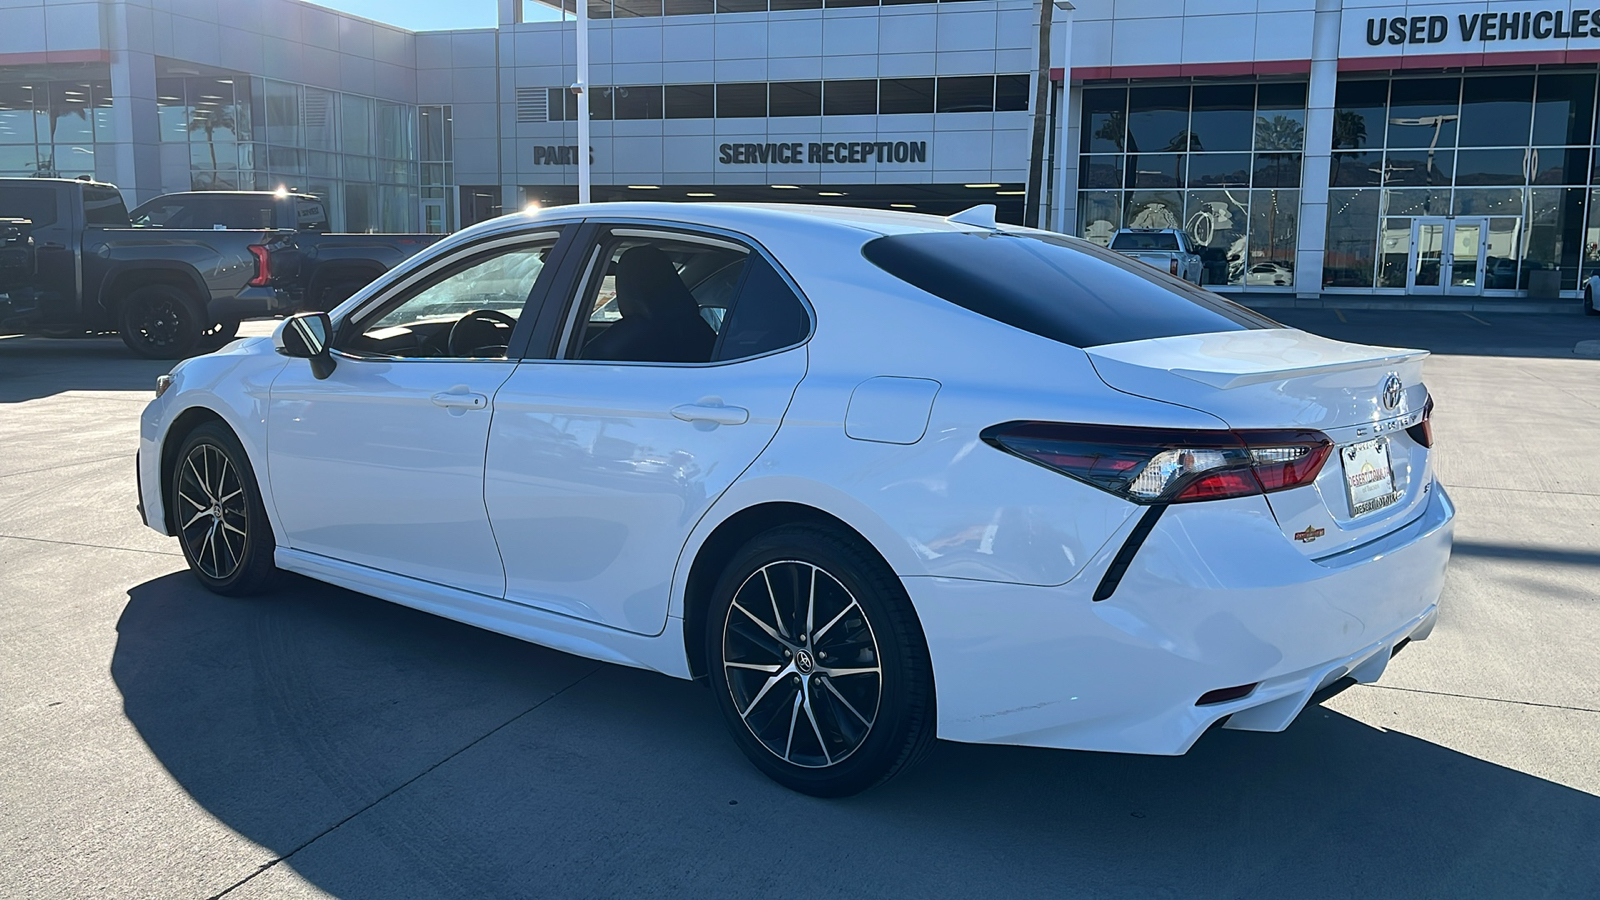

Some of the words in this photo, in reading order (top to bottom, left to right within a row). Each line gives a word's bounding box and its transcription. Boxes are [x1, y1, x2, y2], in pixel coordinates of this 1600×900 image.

[1366, 15, 1448, 46] USED
[1458, 9, 1600, 42] VEHICLES
[719, 142, 804, 164] SERVICE
[808, 141, 926, 164] RECEPTION
